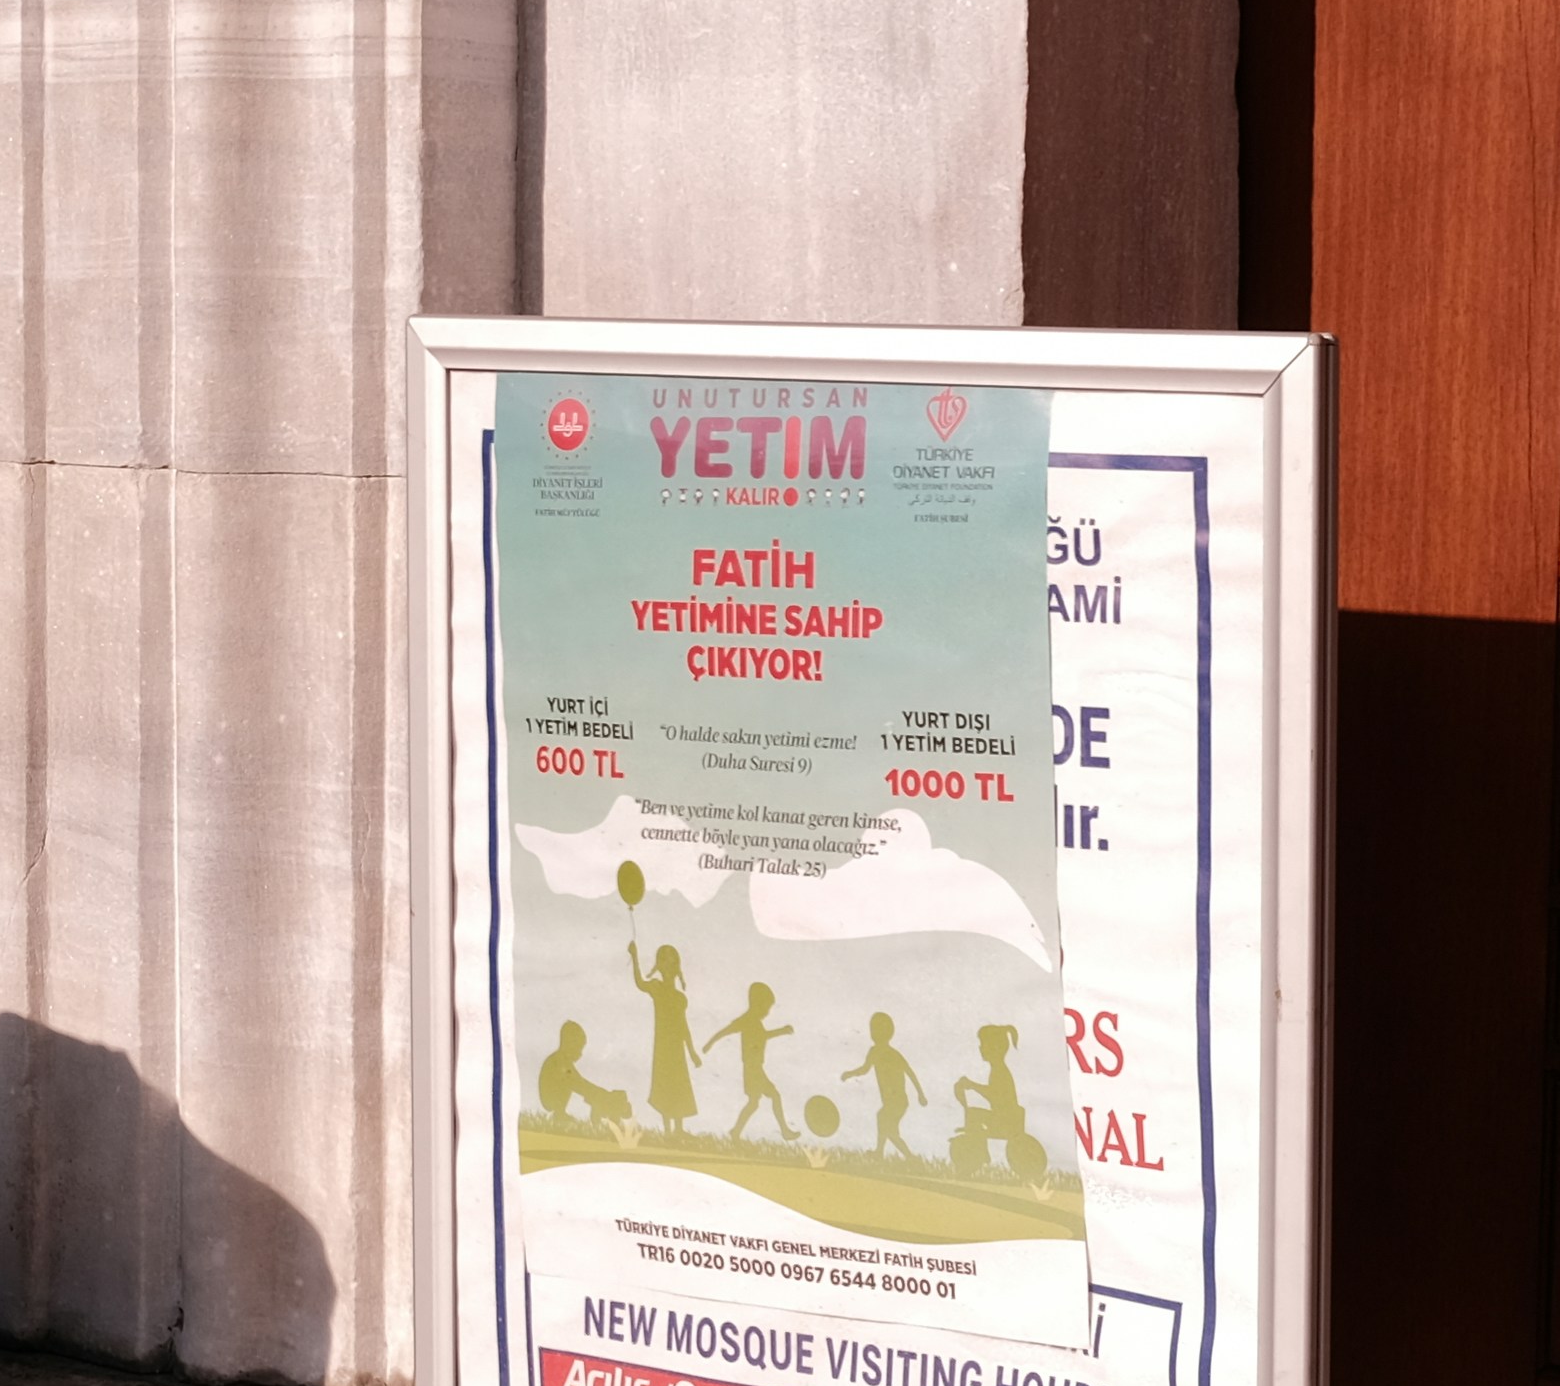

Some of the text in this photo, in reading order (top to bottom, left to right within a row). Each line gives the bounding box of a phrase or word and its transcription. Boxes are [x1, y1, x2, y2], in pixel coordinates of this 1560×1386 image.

[653, 387, 867, 408] UNUTURSAN
[916, 445, 974, 461] TÜRKİYE
[533, 476, 572, 488] DİYANET
[893, 463, 995, 479] DİYANET VAKFI
[541, 489, 594, 501] BAŞKANLIĞI
[693, 538, 814, 589] FATİH
[631, 595, 883, 638] YETİMİNE SAHİP
[687, 645, 823, 682] ÇIKIYOR!
[547, 696, 608, 717] YURT İÇİ
[526, 717, 634, 740] 1 YETİM BEDELİ
[902, 711, 990, 733] YURT DIŞI
[680, 725, 720, 743] halde
[722, 728, 761, 745] sakın
[762, 731, 810, 749] yetimi
[814, 736, 857, 750] ezme!
[881, 732, 1016, 756] 1 YETİM BEDELİ
[536, 746, 624, 778] 600 TL
[702, 752, 813, 776] (Duha Suresi 9)
[885, 768, 1014, 802] 1000 TL
[670, 804, 685, 816] ve
[685, 802, 734, 821] yetime
[737, 805, 759, 822] kol
[762, 806, 805, 825] kanat
[808, 812, 849, 830] geren
[853, 812, 902, 833] kimse,
[1054, 784, 1109, 851] ır.
[641, 826, 701, 843] cennette
[703, 828, 741, 849] böyle
[742, 836, 769, 849] yan
[770, 836, 810, 853] yana
[698, 853, 827, 879] (Buhari Talak 25)
[615, 1218, 977, 1276] TÜRKİYE DİYANET VAKFI GENEL MERKEZİ FATİH ŞUBESİ
[637, 1243, 956, 1300] TR16 0020 5000 0967 6544 8000 01
[584, 1296, 657, 1347] NEW
[666, 1310, 814, 1375] MOSQUE
